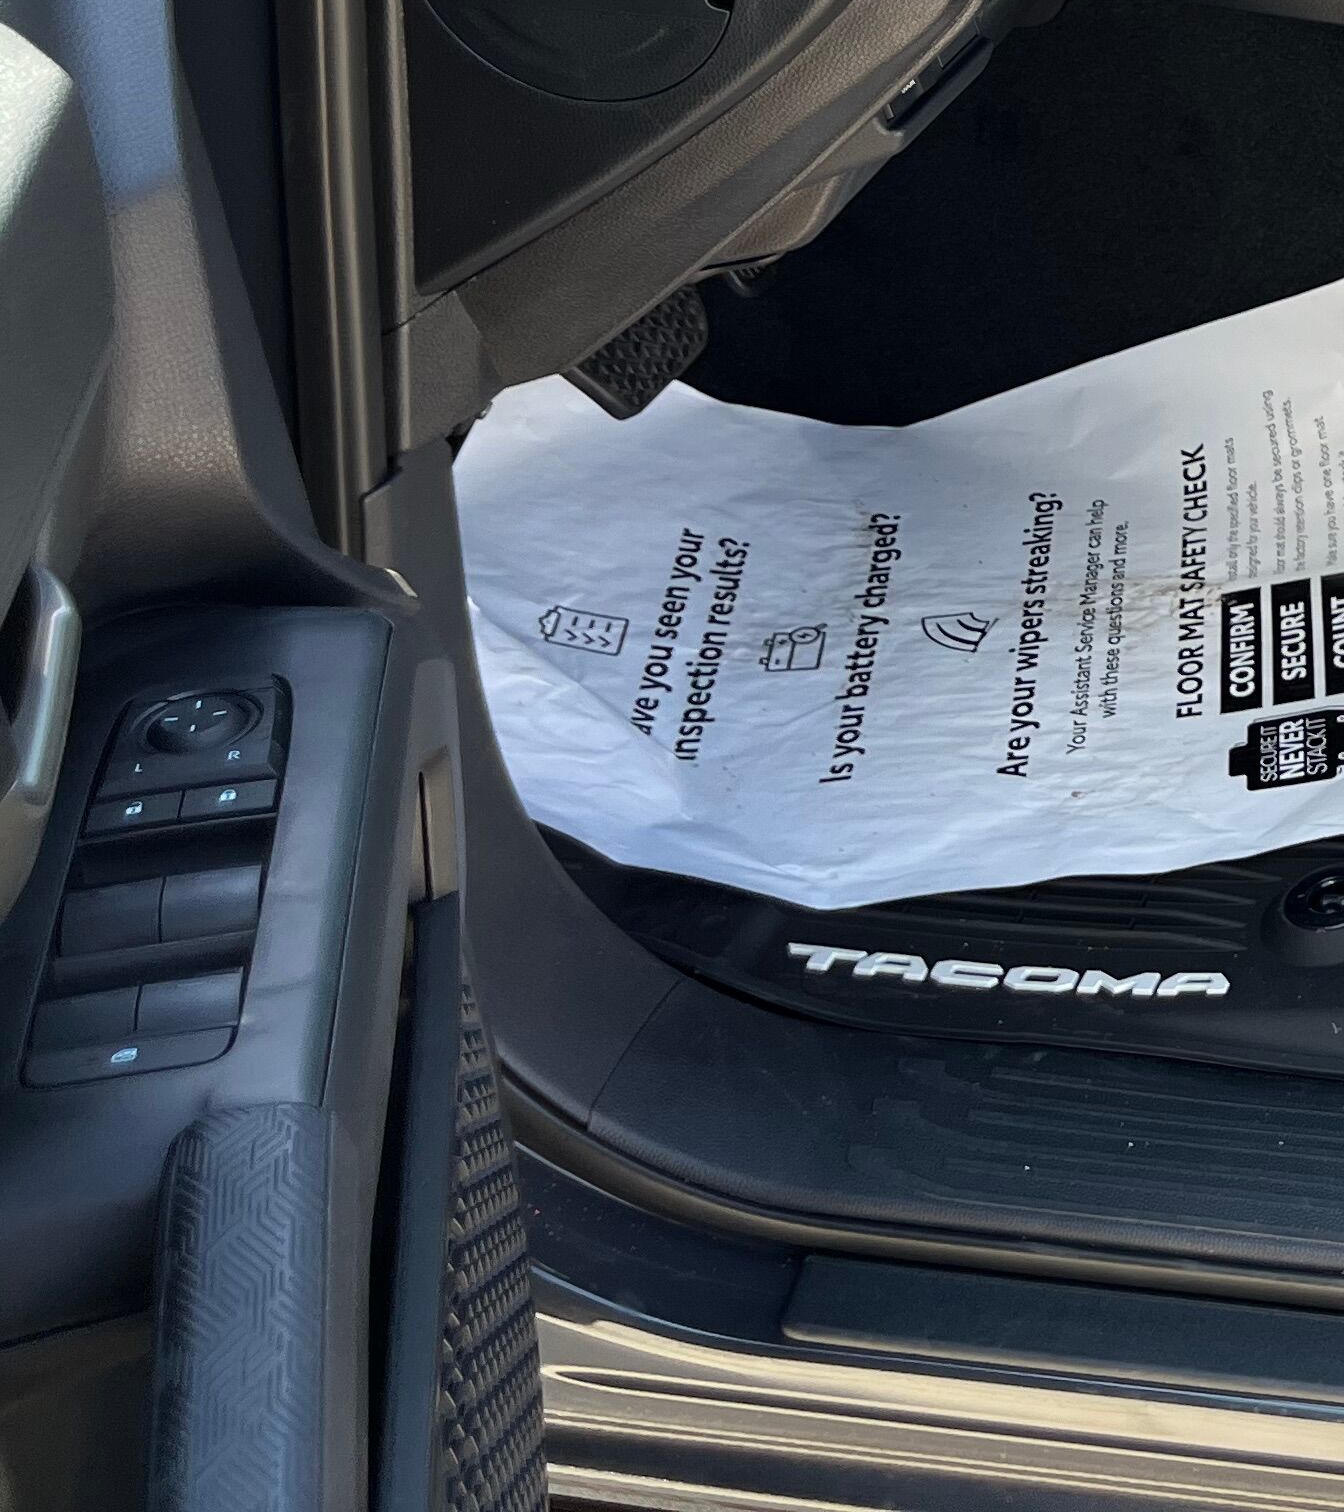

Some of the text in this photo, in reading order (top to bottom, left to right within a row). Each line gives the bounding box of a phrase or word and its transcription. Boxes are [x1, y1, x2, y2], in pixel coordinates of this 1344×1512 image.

[1262, 390, 1275, 421] using
[1313, 415, 1327, 439] mat
[1224, 437, 1236, 464] mats
[1265, 423, 1282, 466] secured
[1176, 443, 1207, 718] FLOOR MAT SAFETY CHECK
[630, 528, 704, 735] ave you seen your
[674, 538, 749, 760] inspection results?
[819, 514, 901, 783] Is your battery charged?
[997, 492, 1062, 777] Are your wipers streaking?
[1066, 499, 1108, 754] Your Assistant Service Manager can help
[1099, 521, 1129, 718] with these questions and more.
[1229, 603, 1255, 697] CONFIRM
[1280, 601, 1307, 680] SECURE
[134, 763, 143, 774] L
[227, 749, 241, 761] R
[1260, 737, 1277, 782] SECURE
[1279, 718, 1305, 780] NEVER
[1306, 729, 1328, 774] STACK
[785, 942, 1232, 1000] TACOMA
